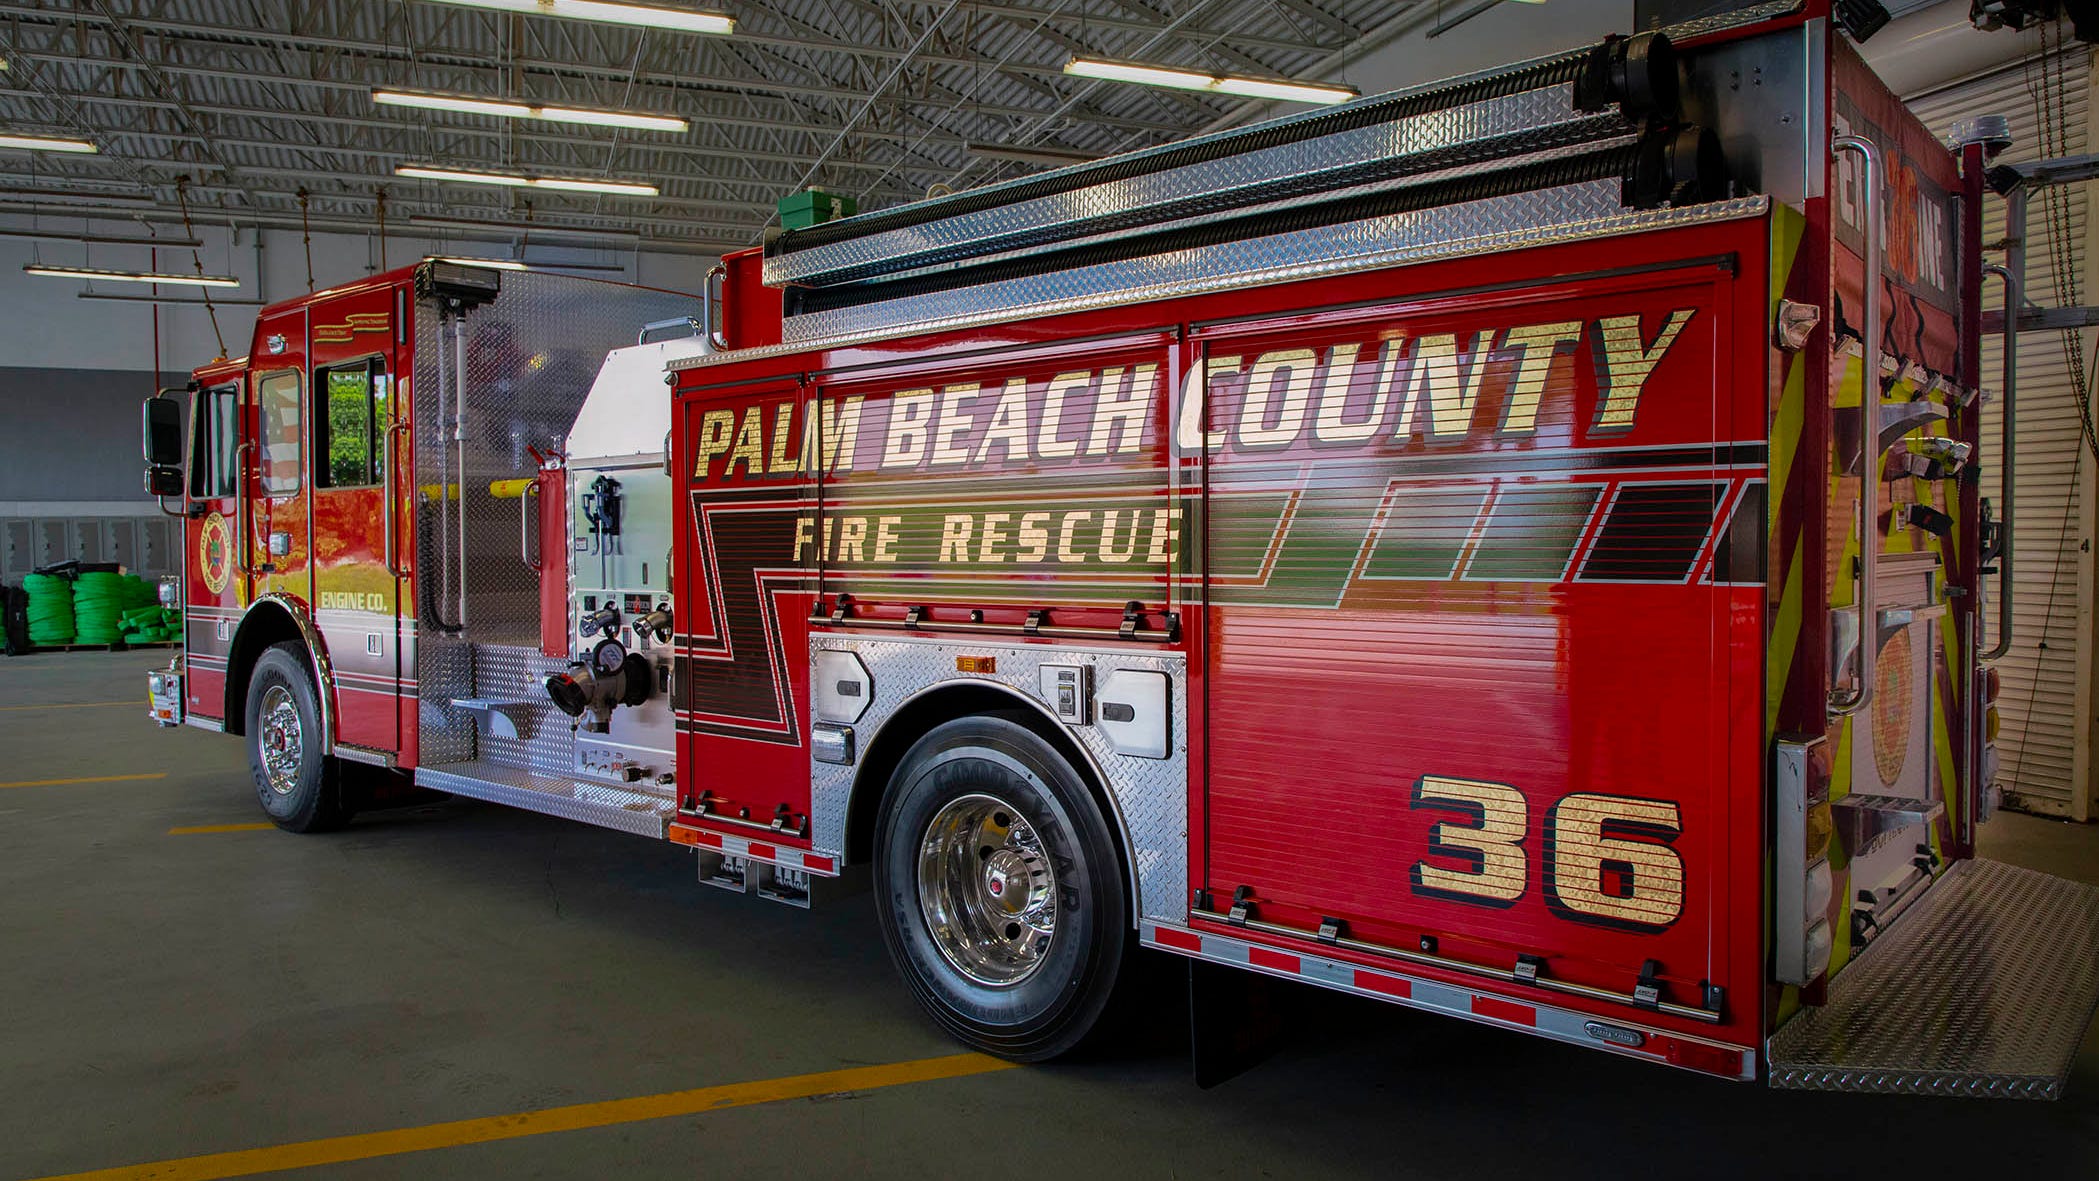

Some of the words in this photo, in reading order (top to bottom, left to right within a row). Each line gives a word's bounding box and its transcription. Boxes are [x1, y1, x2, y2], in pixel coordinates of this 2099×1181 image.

[694, 393, 866, 478] PALM
[881, 369, 1157, 467] BEACH
[1177, 309, 1696, 449] COUNTY
[793, 516, 902, 563] FIRE
[938, 508, 1183, 563] RESCUE
[321, 591, 365, 610] ENGINE
[367, 592, 388, 612] CO.
[1414, 774, 1684, 930] 36
